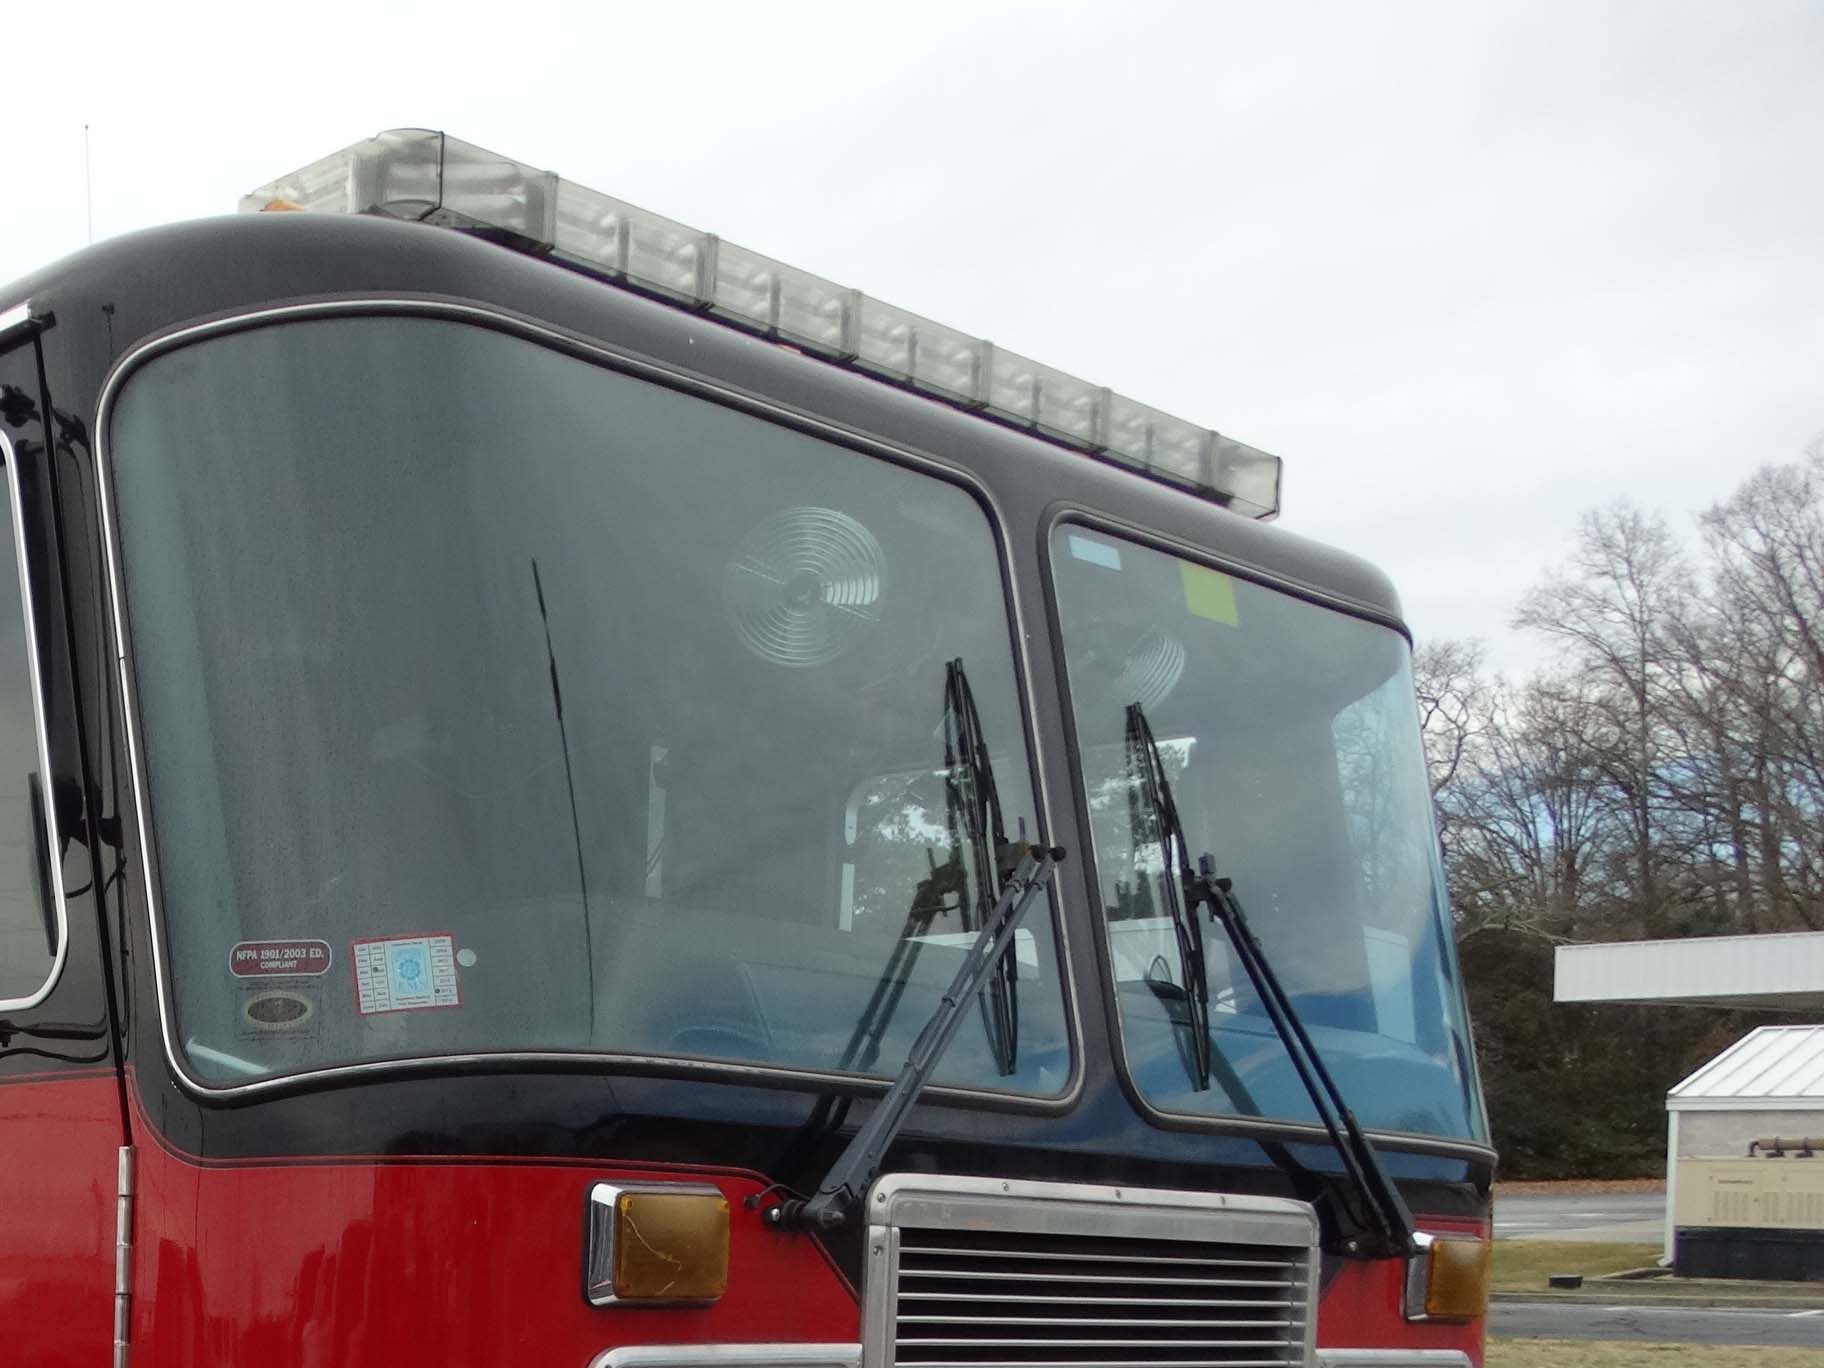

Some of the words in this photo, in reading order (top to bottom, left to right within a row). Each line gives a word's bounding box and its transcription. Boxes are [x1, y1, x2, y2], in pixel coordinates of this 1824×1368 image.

[236, 949, 257, 961] NFPA
[260, 947, 306, 960] 1901/2003
[309, 947, 325, 959] ED.
[260, 960, 297, 969] COMPLIANT
